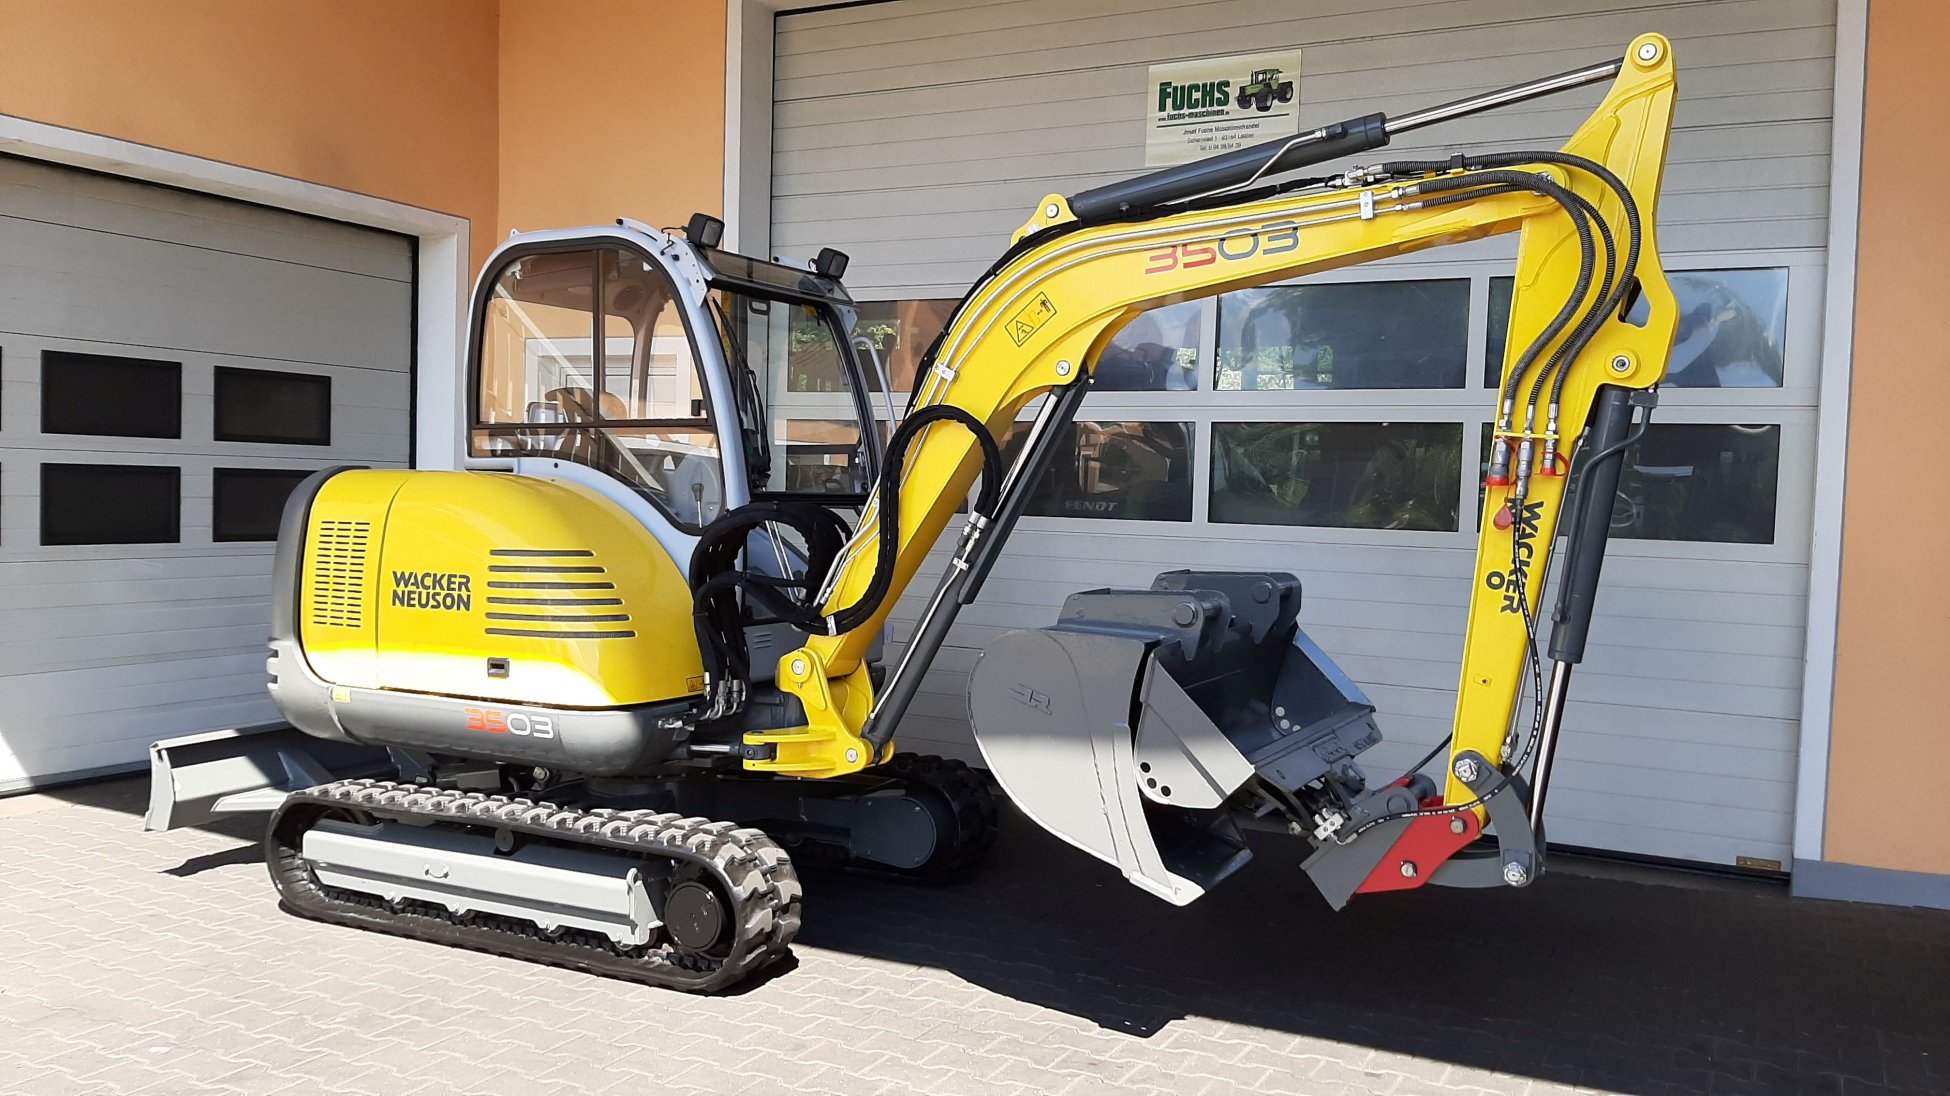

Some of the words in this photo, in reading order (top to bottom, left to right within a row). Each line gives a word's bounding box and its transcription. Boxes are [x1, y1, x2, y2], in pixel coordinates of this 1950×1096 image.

[1158, 80, 1230, 112] FUCHS
[1144, 220, 1299, 275] 3503
[1500, 501, 1545, 614] WACKER
[392, 570, 471, 593] WACKER
[392, 590, 471, 612] NEUSON
[464, 707, 554, 739] 3503
